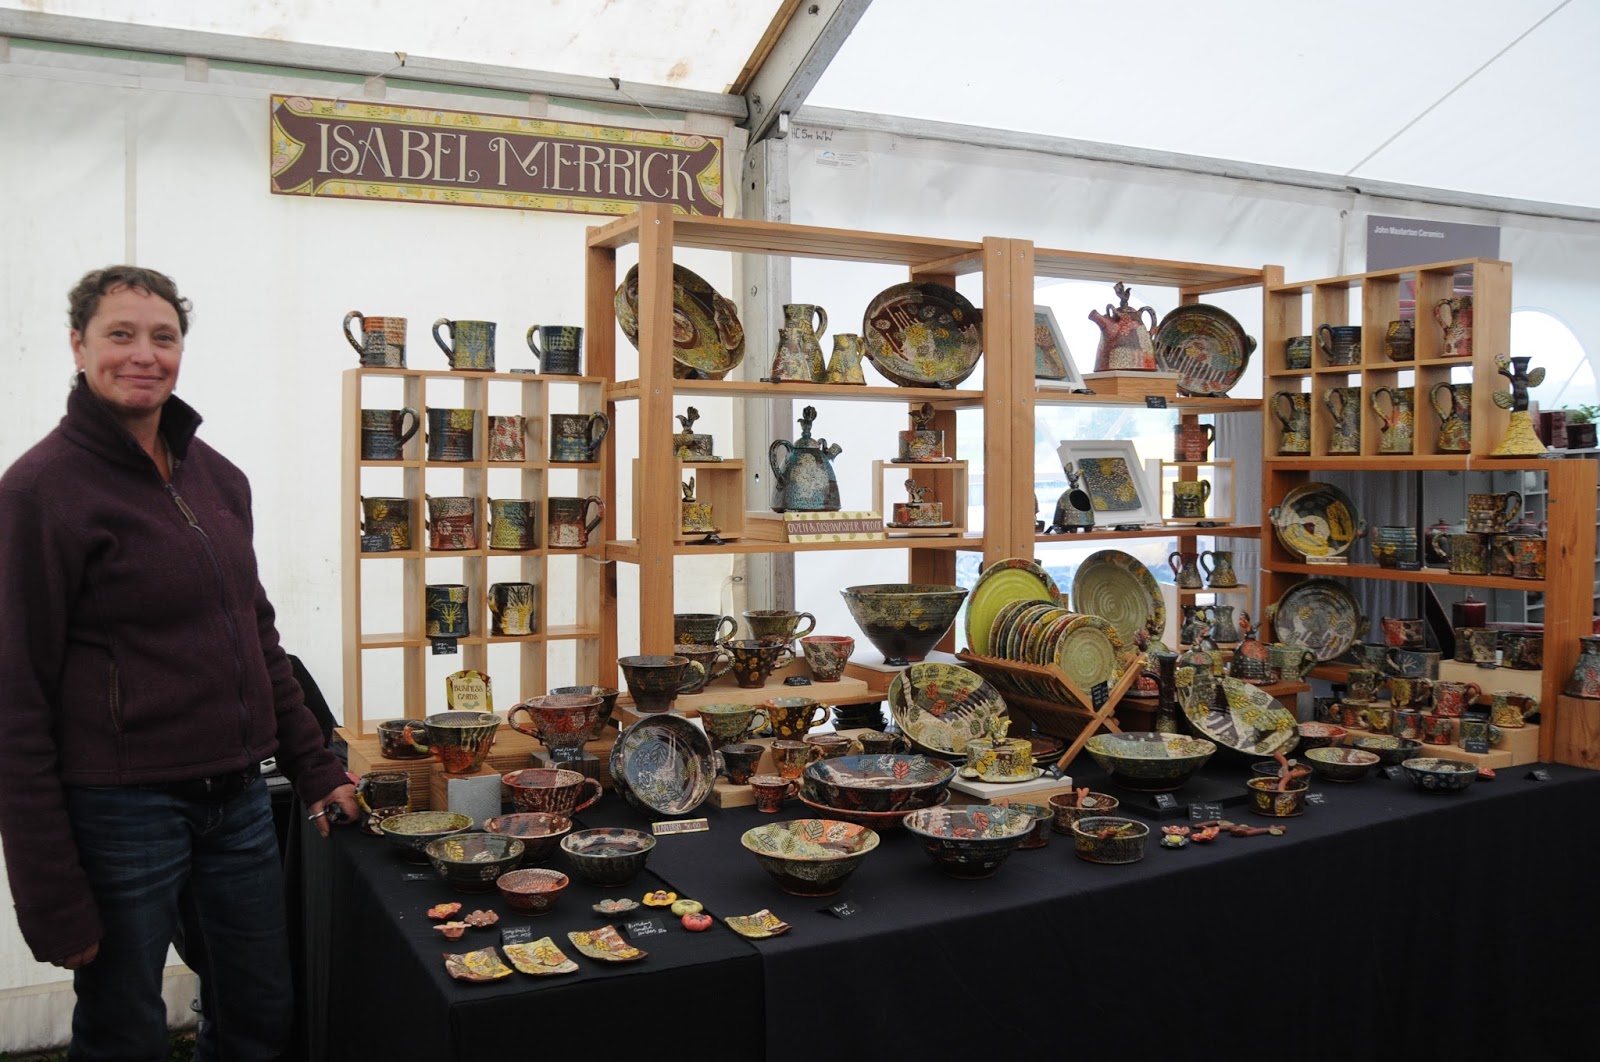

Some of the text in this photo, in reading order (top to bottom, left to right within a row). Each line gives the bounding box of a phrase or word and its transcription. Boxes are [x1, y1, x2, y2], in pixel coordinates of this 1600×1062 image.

[316, 122, 696, 201] ISABEL MERRICK
[788, 522, 808, 533] OVEN
[816, 521, 861, 532] DISHWASHER
[862, 520, 882, 531] PROOF
[454, 684, 483, 692] BUSINESS
[457, 693, 478, 701] CARDS
